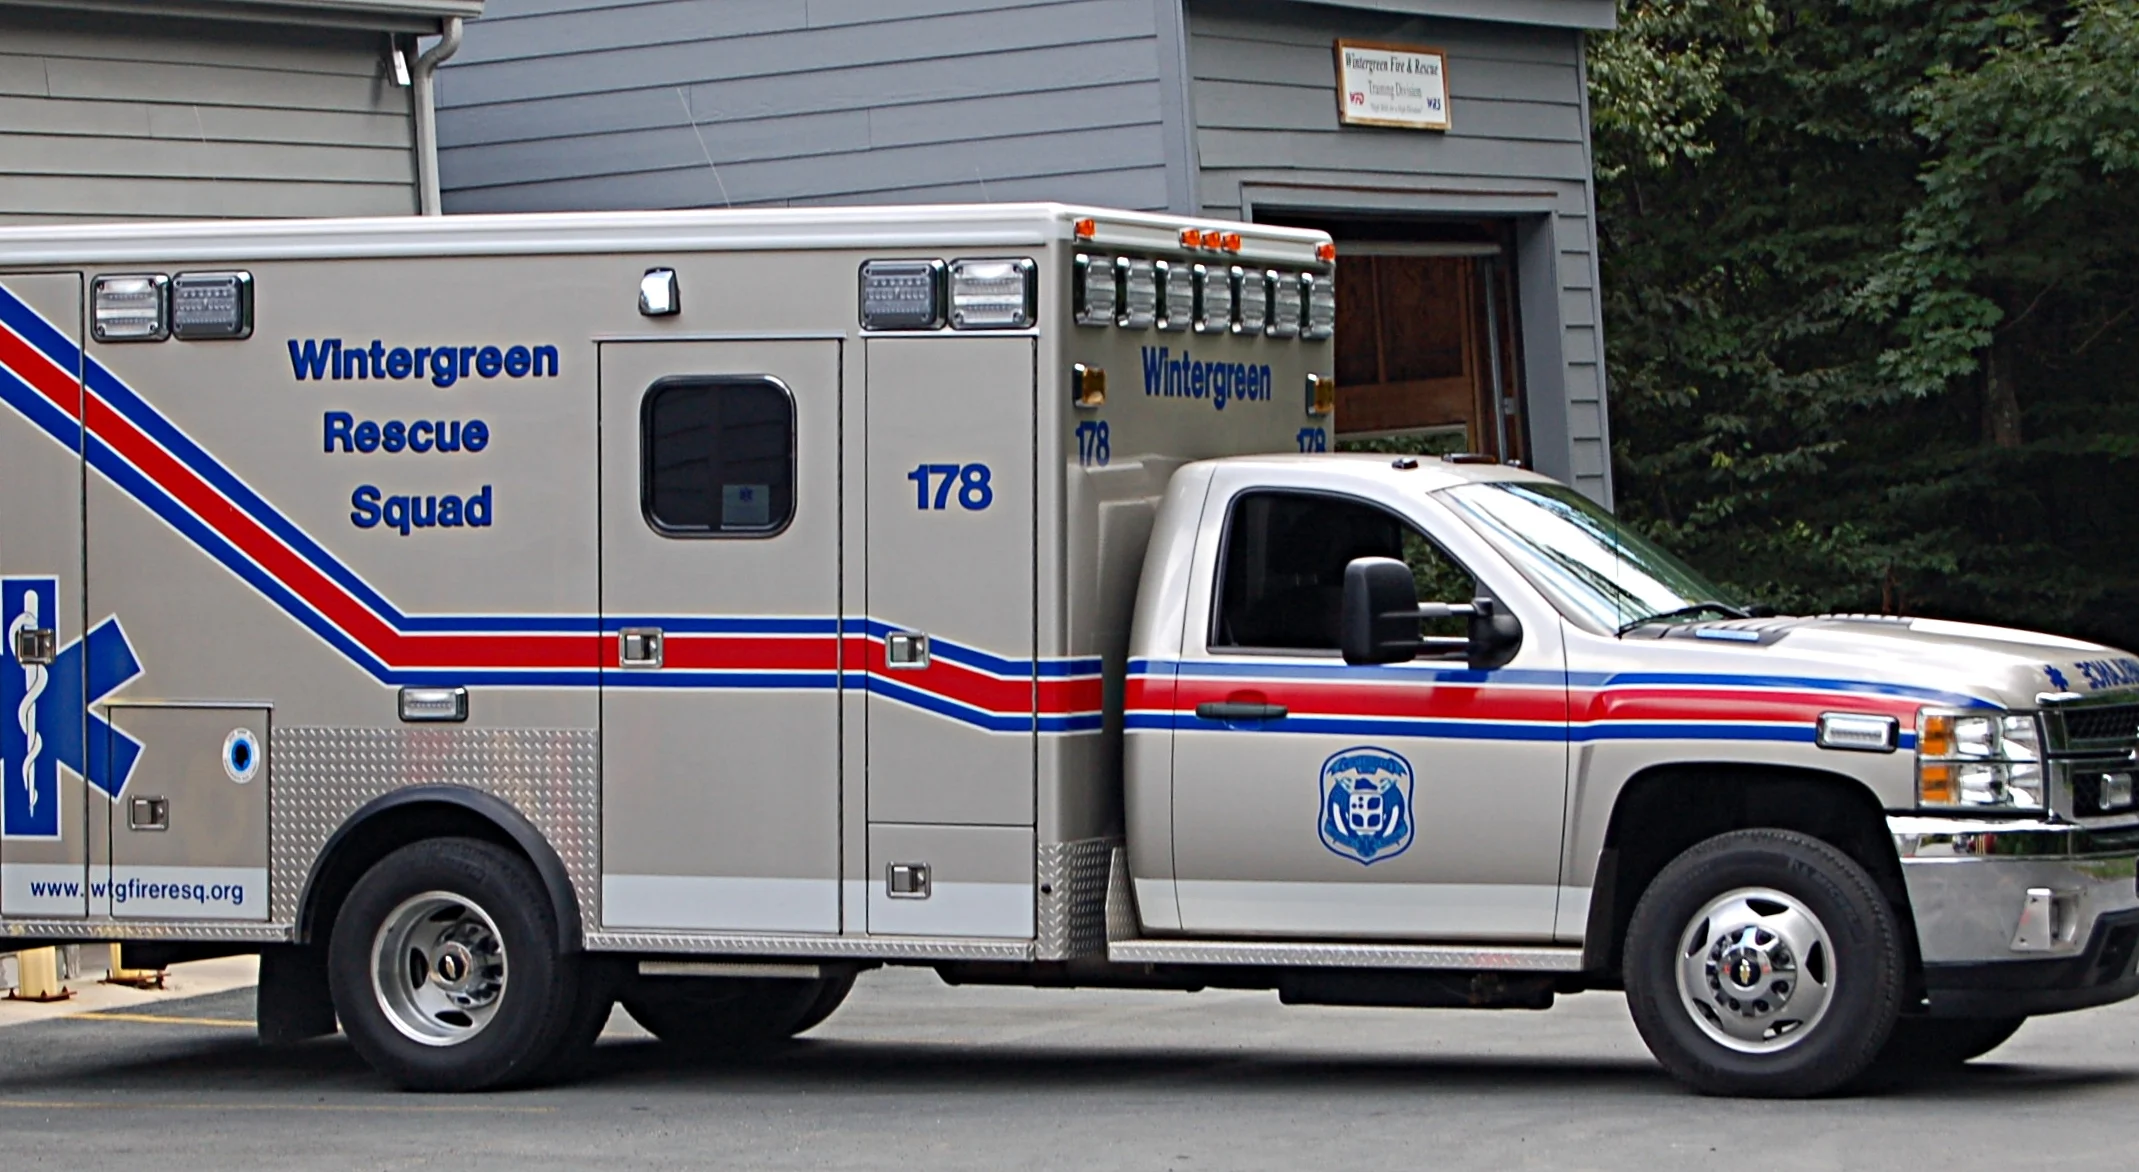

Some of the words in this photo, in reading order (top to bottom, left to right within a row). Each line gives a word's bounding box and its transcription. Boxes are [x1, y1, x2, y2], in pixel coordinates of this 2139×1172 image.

[1345, 52, 1388, 75] Wintergreen
[1390, 56, 1405, 73] Fire
[1406, 58, 1413, 74] &
[1415, 59, 1438, 76] Rescue
[1368, 80, 1395, 101] Training
[1395, 82, 1422, 99] Division
[287, 338, 559, 388] Wintergreen
[1141, 346, 1272, 411] Wintergreen
[323, 411, 489, 453] Rescue
[1075, 420, 1110, 467] 178
[1296, 426, 1326, 453] 178
[907, 463, 993, 511] 178
[350, 484, 492, 536] Squad
[31, 878, 244, 905] www.wtgfireresq.org
